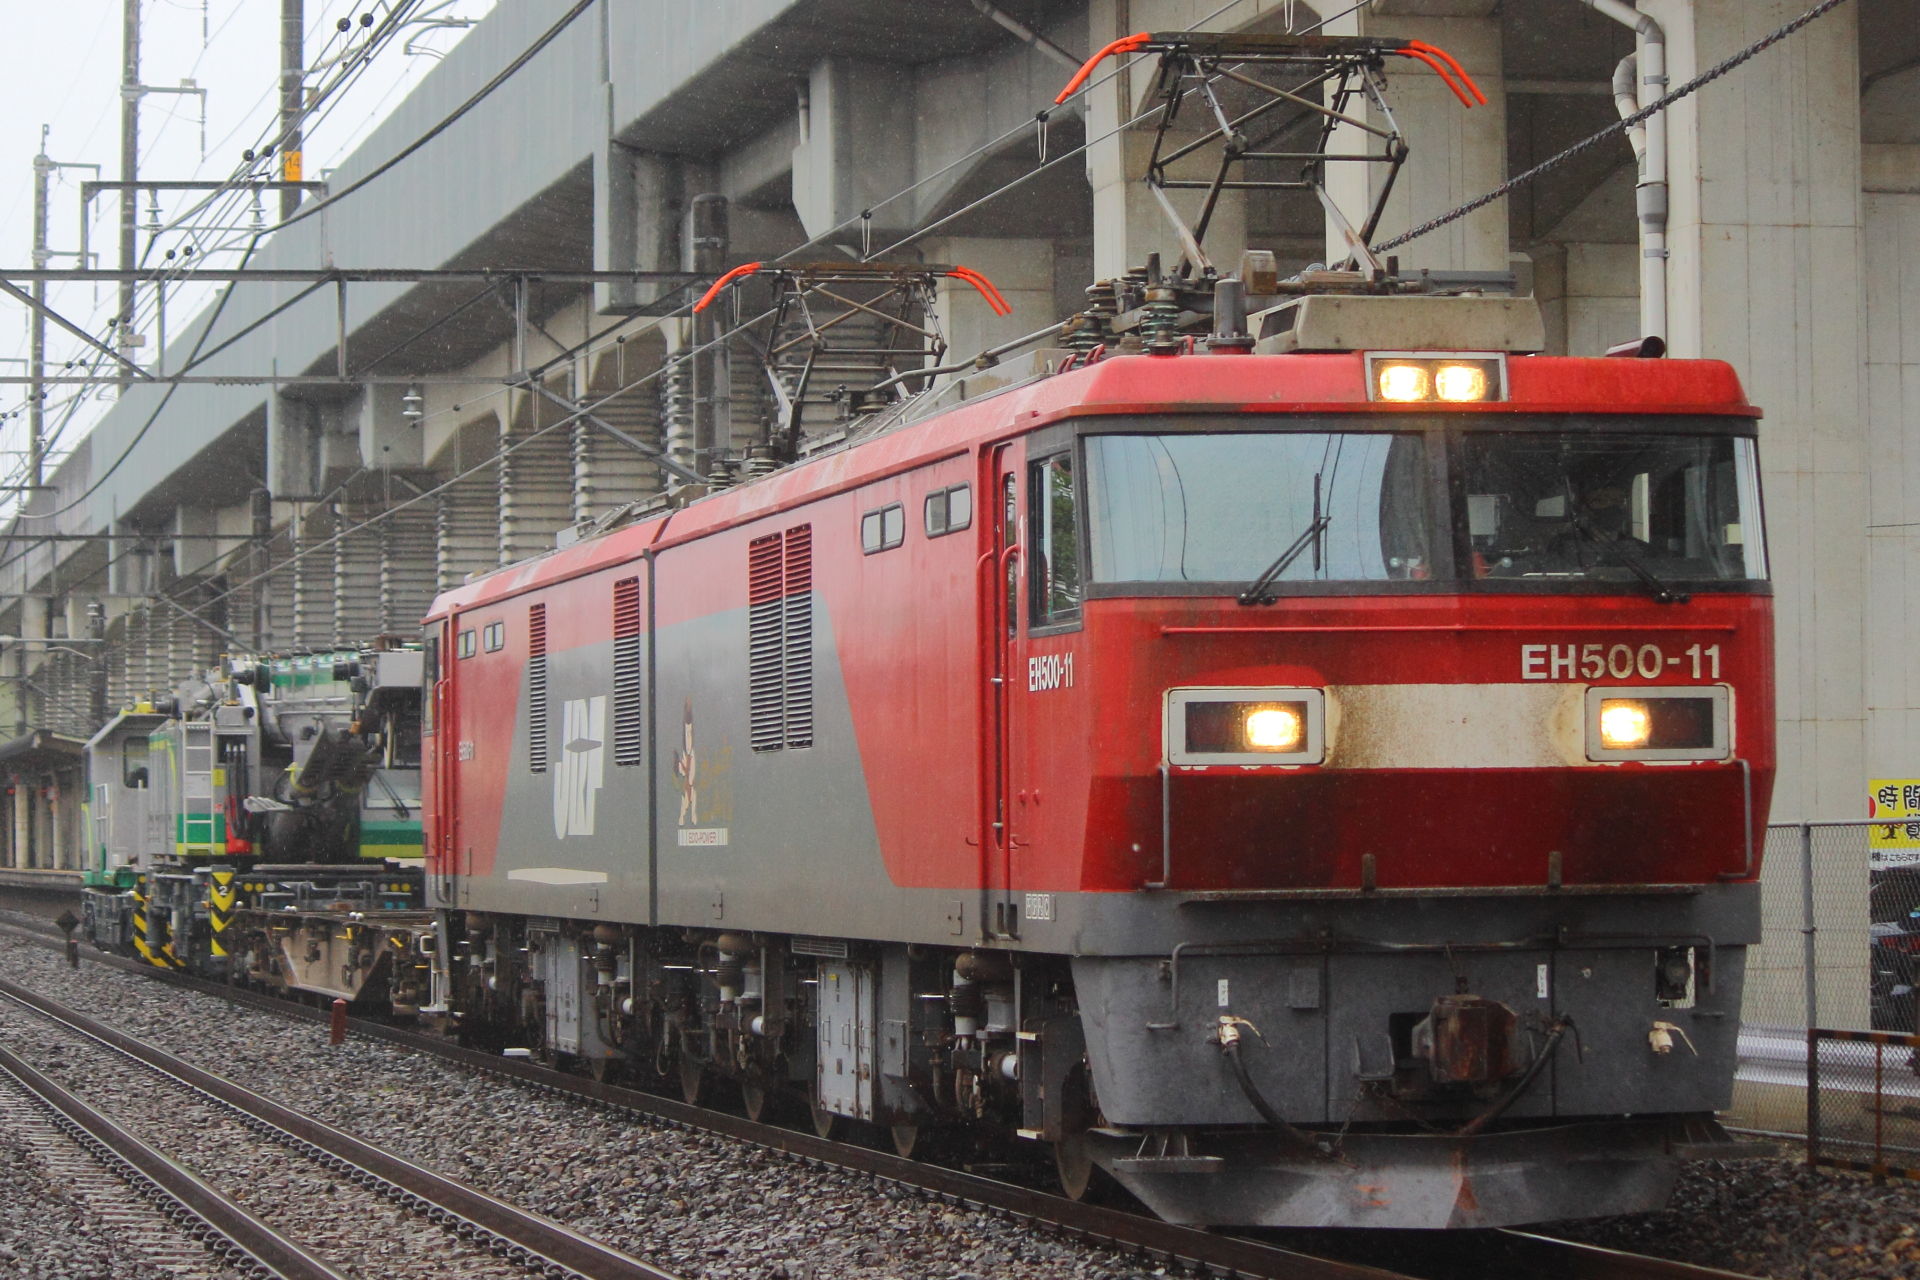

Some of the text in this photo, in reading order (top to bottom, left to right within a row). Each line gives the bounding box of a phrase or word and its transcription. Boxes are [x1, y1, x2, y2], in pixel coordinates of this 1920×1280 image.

[1028, 651, 1073, 692] EH500-11
[1521, 643, 1720, 680] EH500-11
[1878, 784, 1920, 811] 時間
[218, 885, 228, 896] 2
